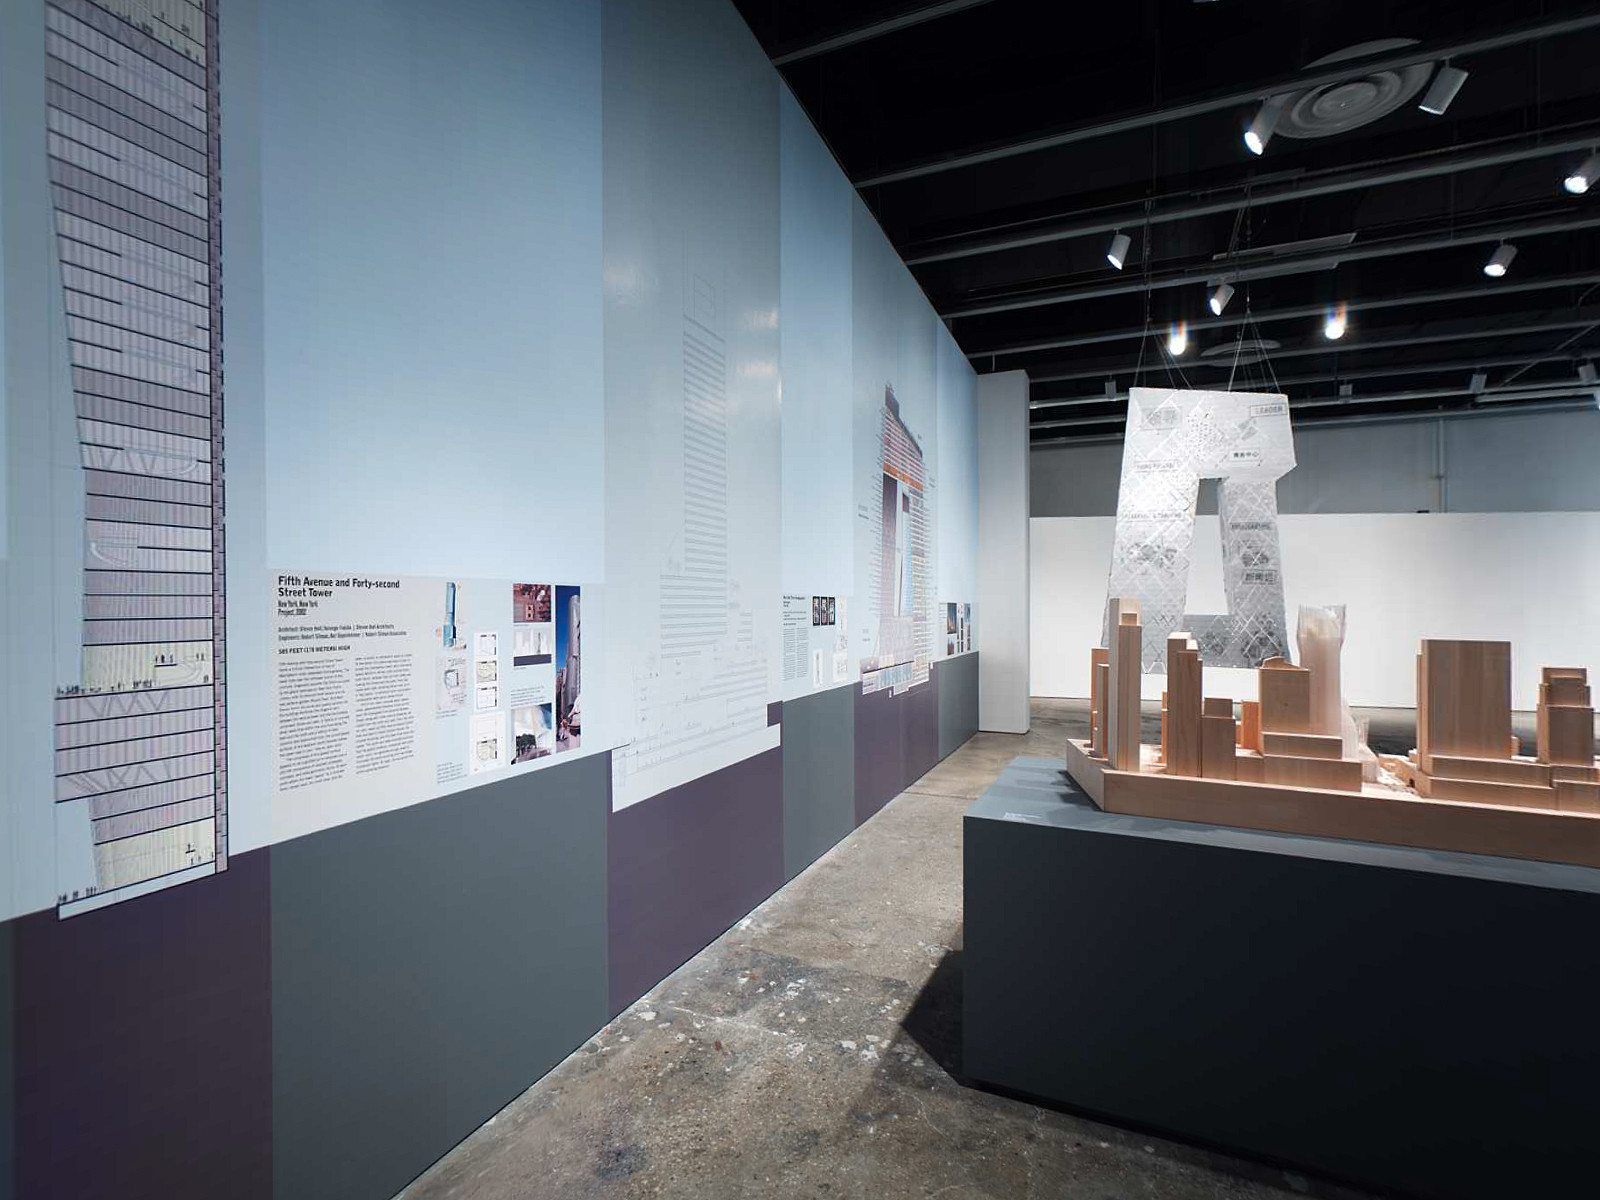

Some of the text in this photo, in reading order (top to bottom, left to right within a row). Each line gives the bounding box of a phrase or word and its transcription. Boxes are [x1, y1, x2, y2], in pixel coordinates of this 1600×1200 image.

[278, 576, 400, 589] Fifth Avenue and Forty-second
[278, 587, 333, 597] Street Tower
